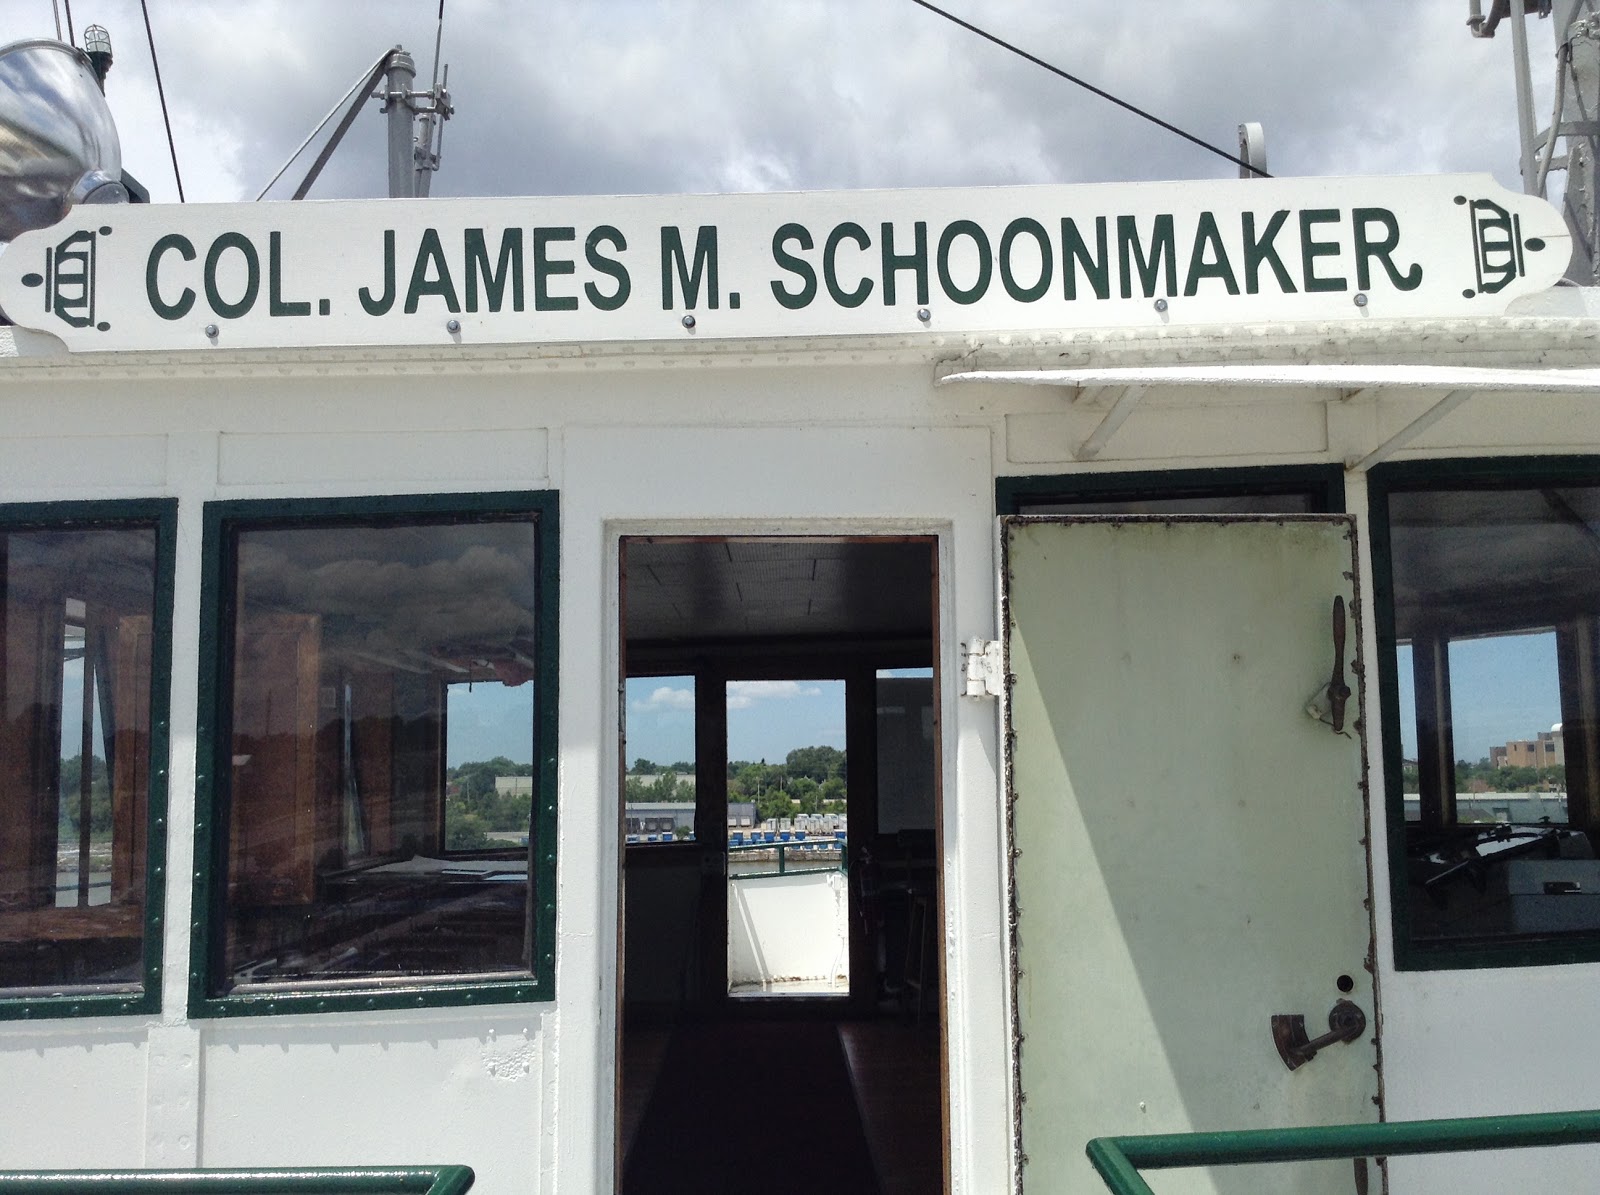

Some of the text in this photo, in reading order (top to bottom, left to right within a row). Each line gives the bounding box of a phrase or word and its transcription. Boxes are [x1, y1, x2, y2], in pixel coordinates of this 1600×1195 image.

[145, 207, 1423, 320] COL. JAMES M. SCHOONMAKER
